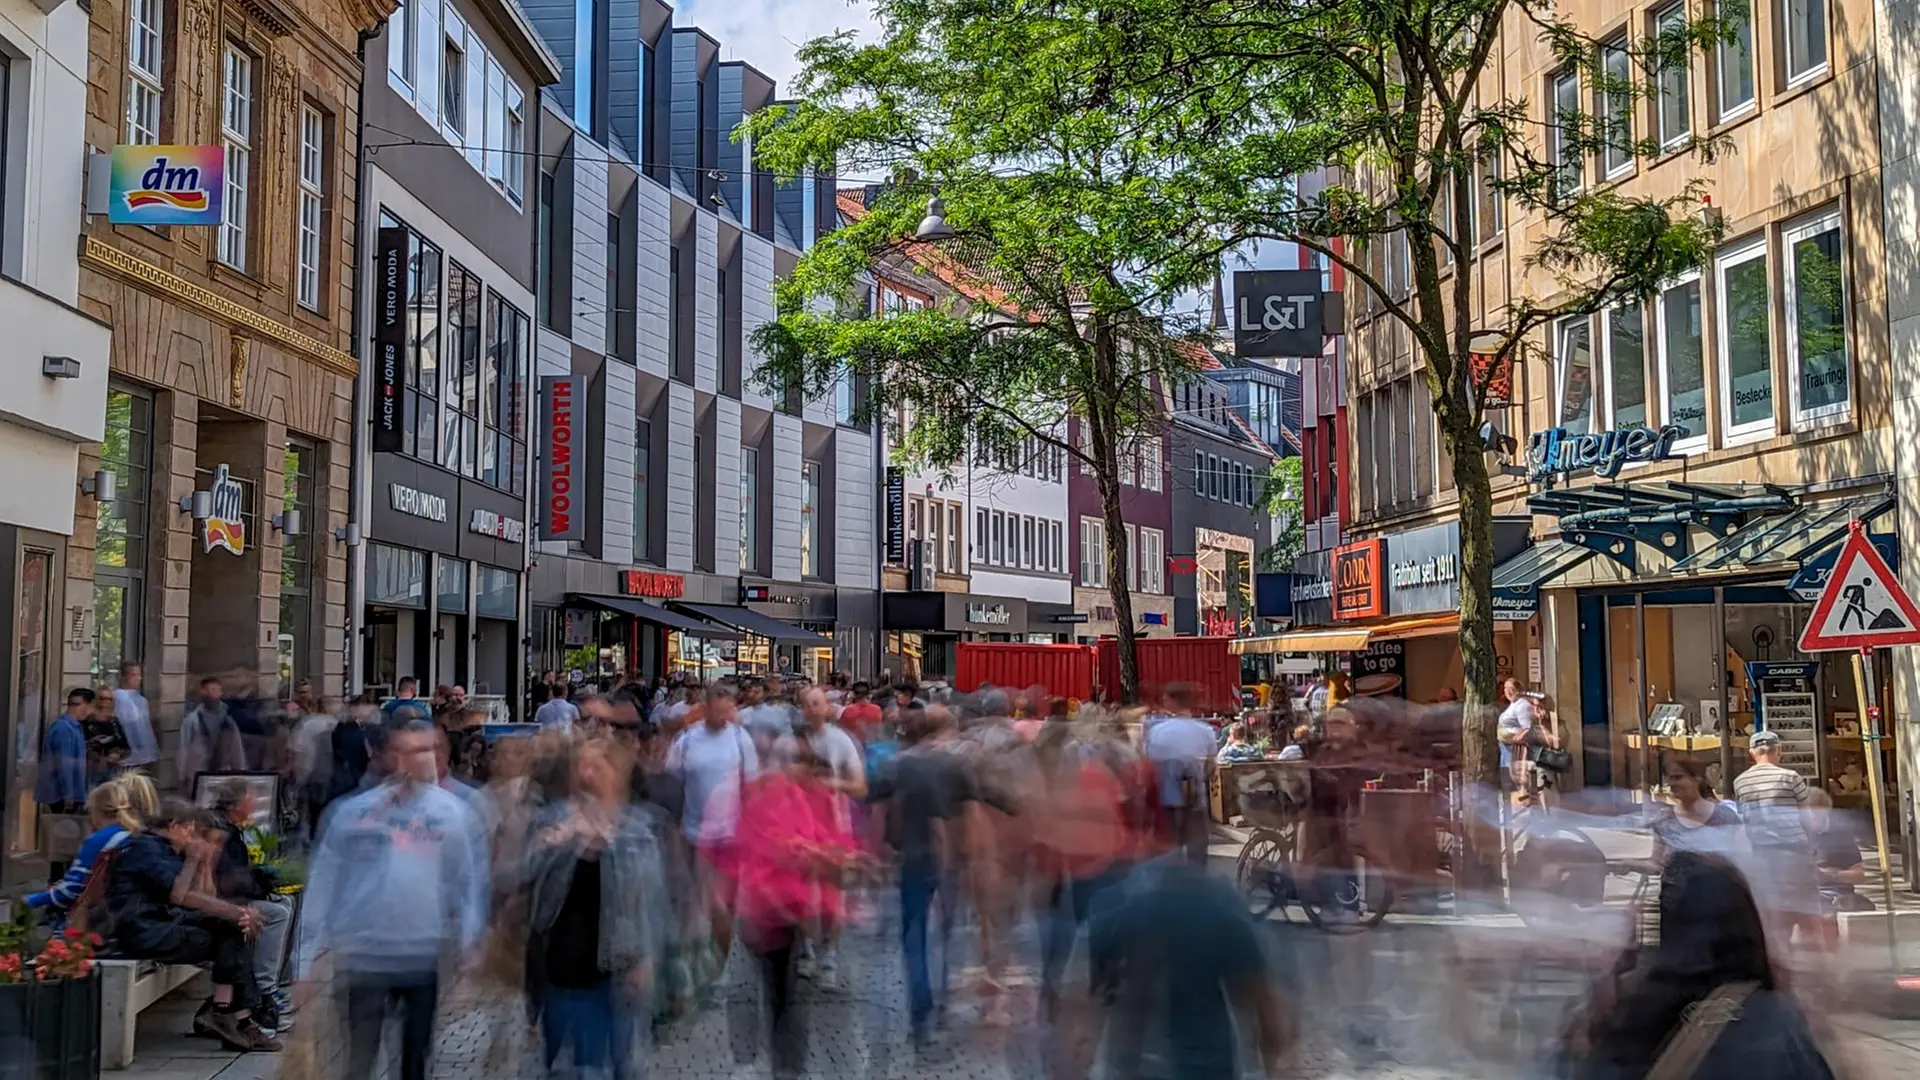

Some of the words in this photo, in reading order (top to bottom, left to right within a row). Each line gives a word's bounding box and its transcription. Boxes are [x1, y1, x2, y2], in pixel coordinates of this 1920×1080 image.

[142, 158, 199, 190] dm
[387, 249, 397, 289] MODA
[386, 293, 396, 325] VERO
[1240, 295, 1315, 331] L&T
[551, 382, 572, 535] WOOLWORTH
[215, 468, 241, 522] dm
[393, 483, 419, 516] VERO
[419, 491, 446, 522] MODA
[1336, 551, 1371, 587] COORS
[1391, 560, 1420, 588] Tradition
[1421, 556, 1436, 584] seit
[1436, 553, 1454, 581] 1911
[1492, 596, 1536, 610] lkmeyer
[1364, 658, 1377, 671] to
[1380, 657, 1396, 672] go
[1768, 667, 1804, 675] CASIO
